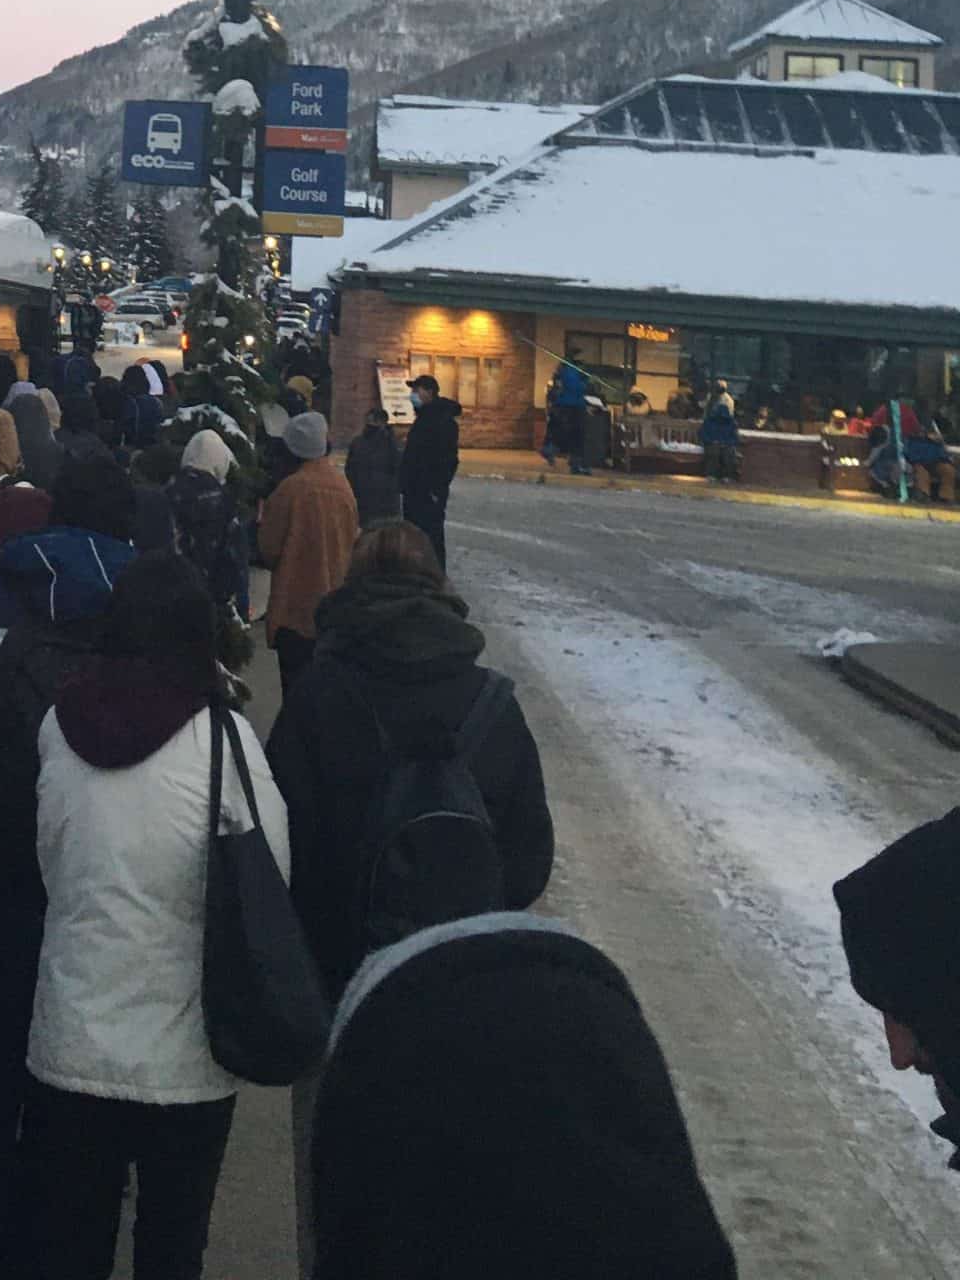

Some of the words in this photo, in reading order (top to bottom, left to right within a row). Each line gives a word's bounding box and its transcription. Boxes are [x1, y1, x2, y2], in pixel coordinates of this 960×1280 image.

[292, 82, 323, 98] Ford
[291, 100, 323, 116] Park
[291, 167, 320, 183] Golf
[280, 185, 328, 202] Course
